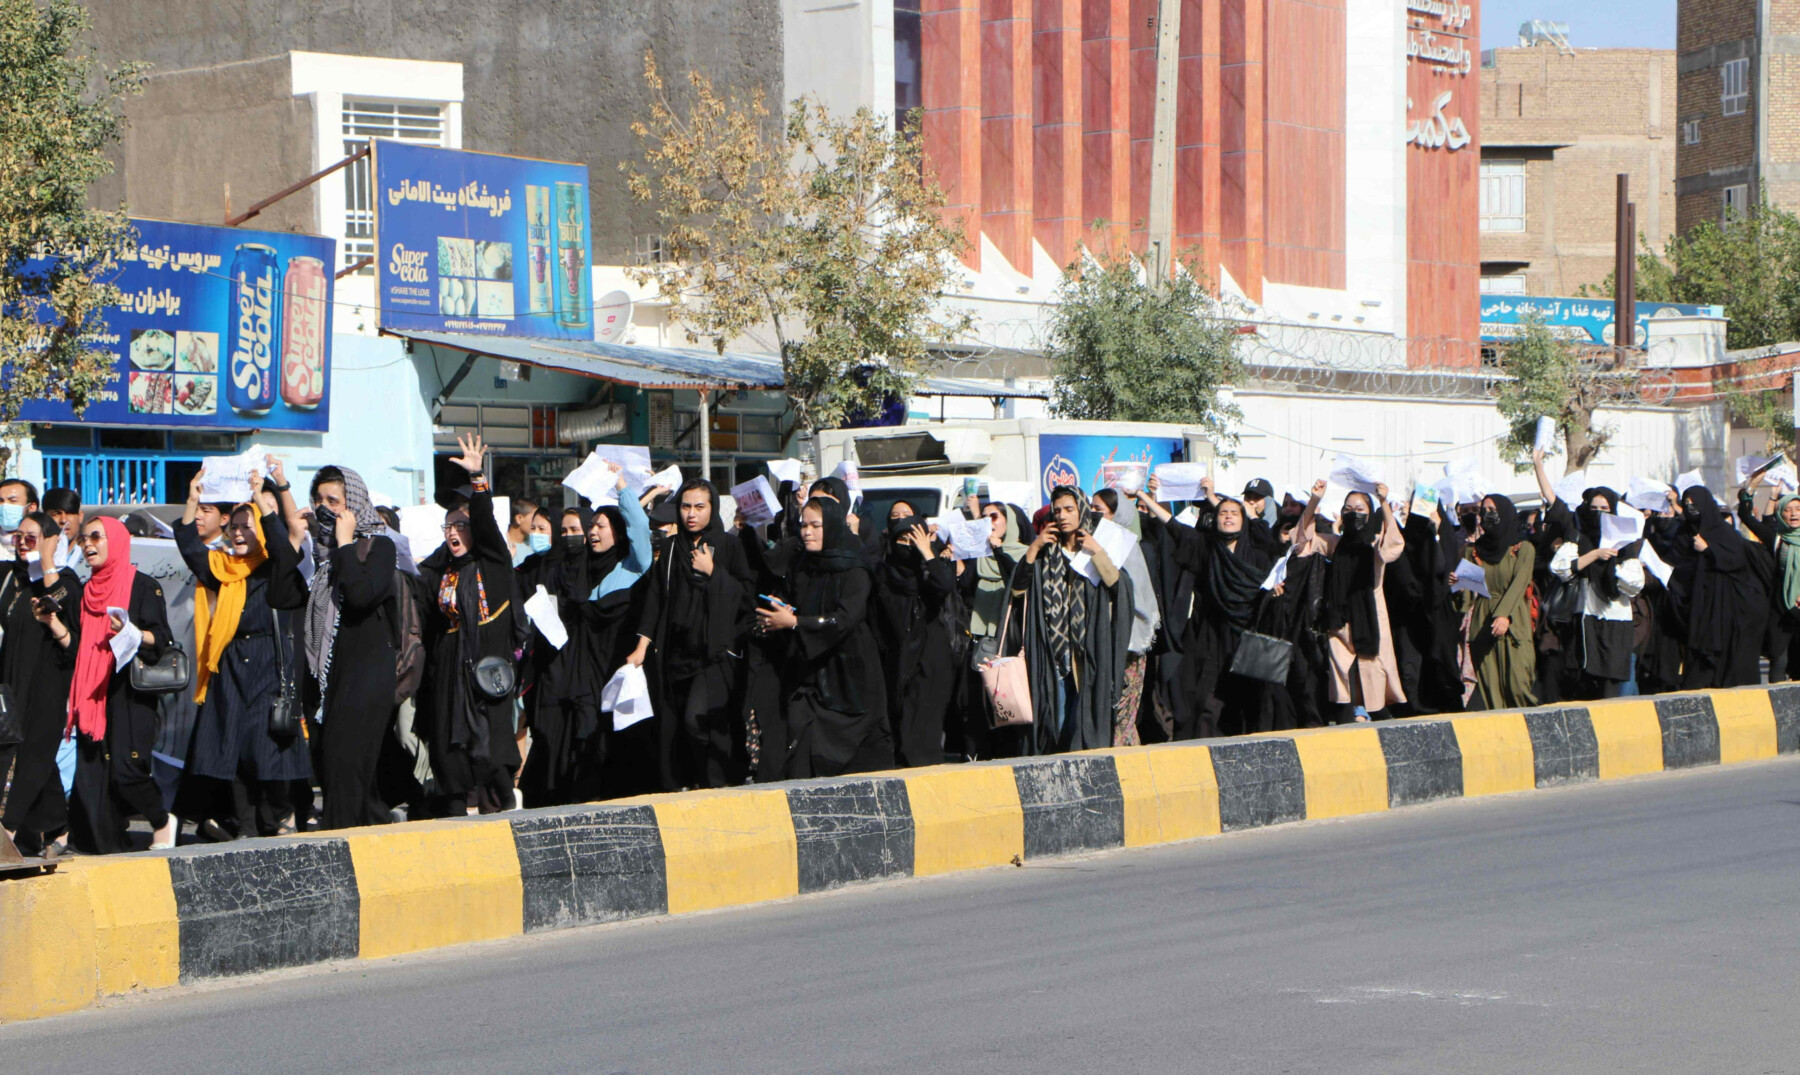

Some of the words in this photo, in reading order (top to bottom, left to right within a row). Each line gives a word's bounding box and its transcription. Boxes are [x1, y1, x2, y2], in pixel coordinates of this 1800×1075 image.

[388, 179, 431, 206] الامانی
[432, 184, 457, 211] بیت
[458, 180, 512, 217] فروشگاه
[139, 244, 170, 270] تهیه
[389, 243, 429, 275] Super
[135, 286, 181, 316] برادران
[417, 288, 430, 297] LOVE
[1481, 301, 1513, 317] حاجی
[1562, 308, 1570, 320] و
[1571, 304, 1590, 317] غذا
[231, 271, 260, 400] Super
[285, 282, 310, 397] Super
